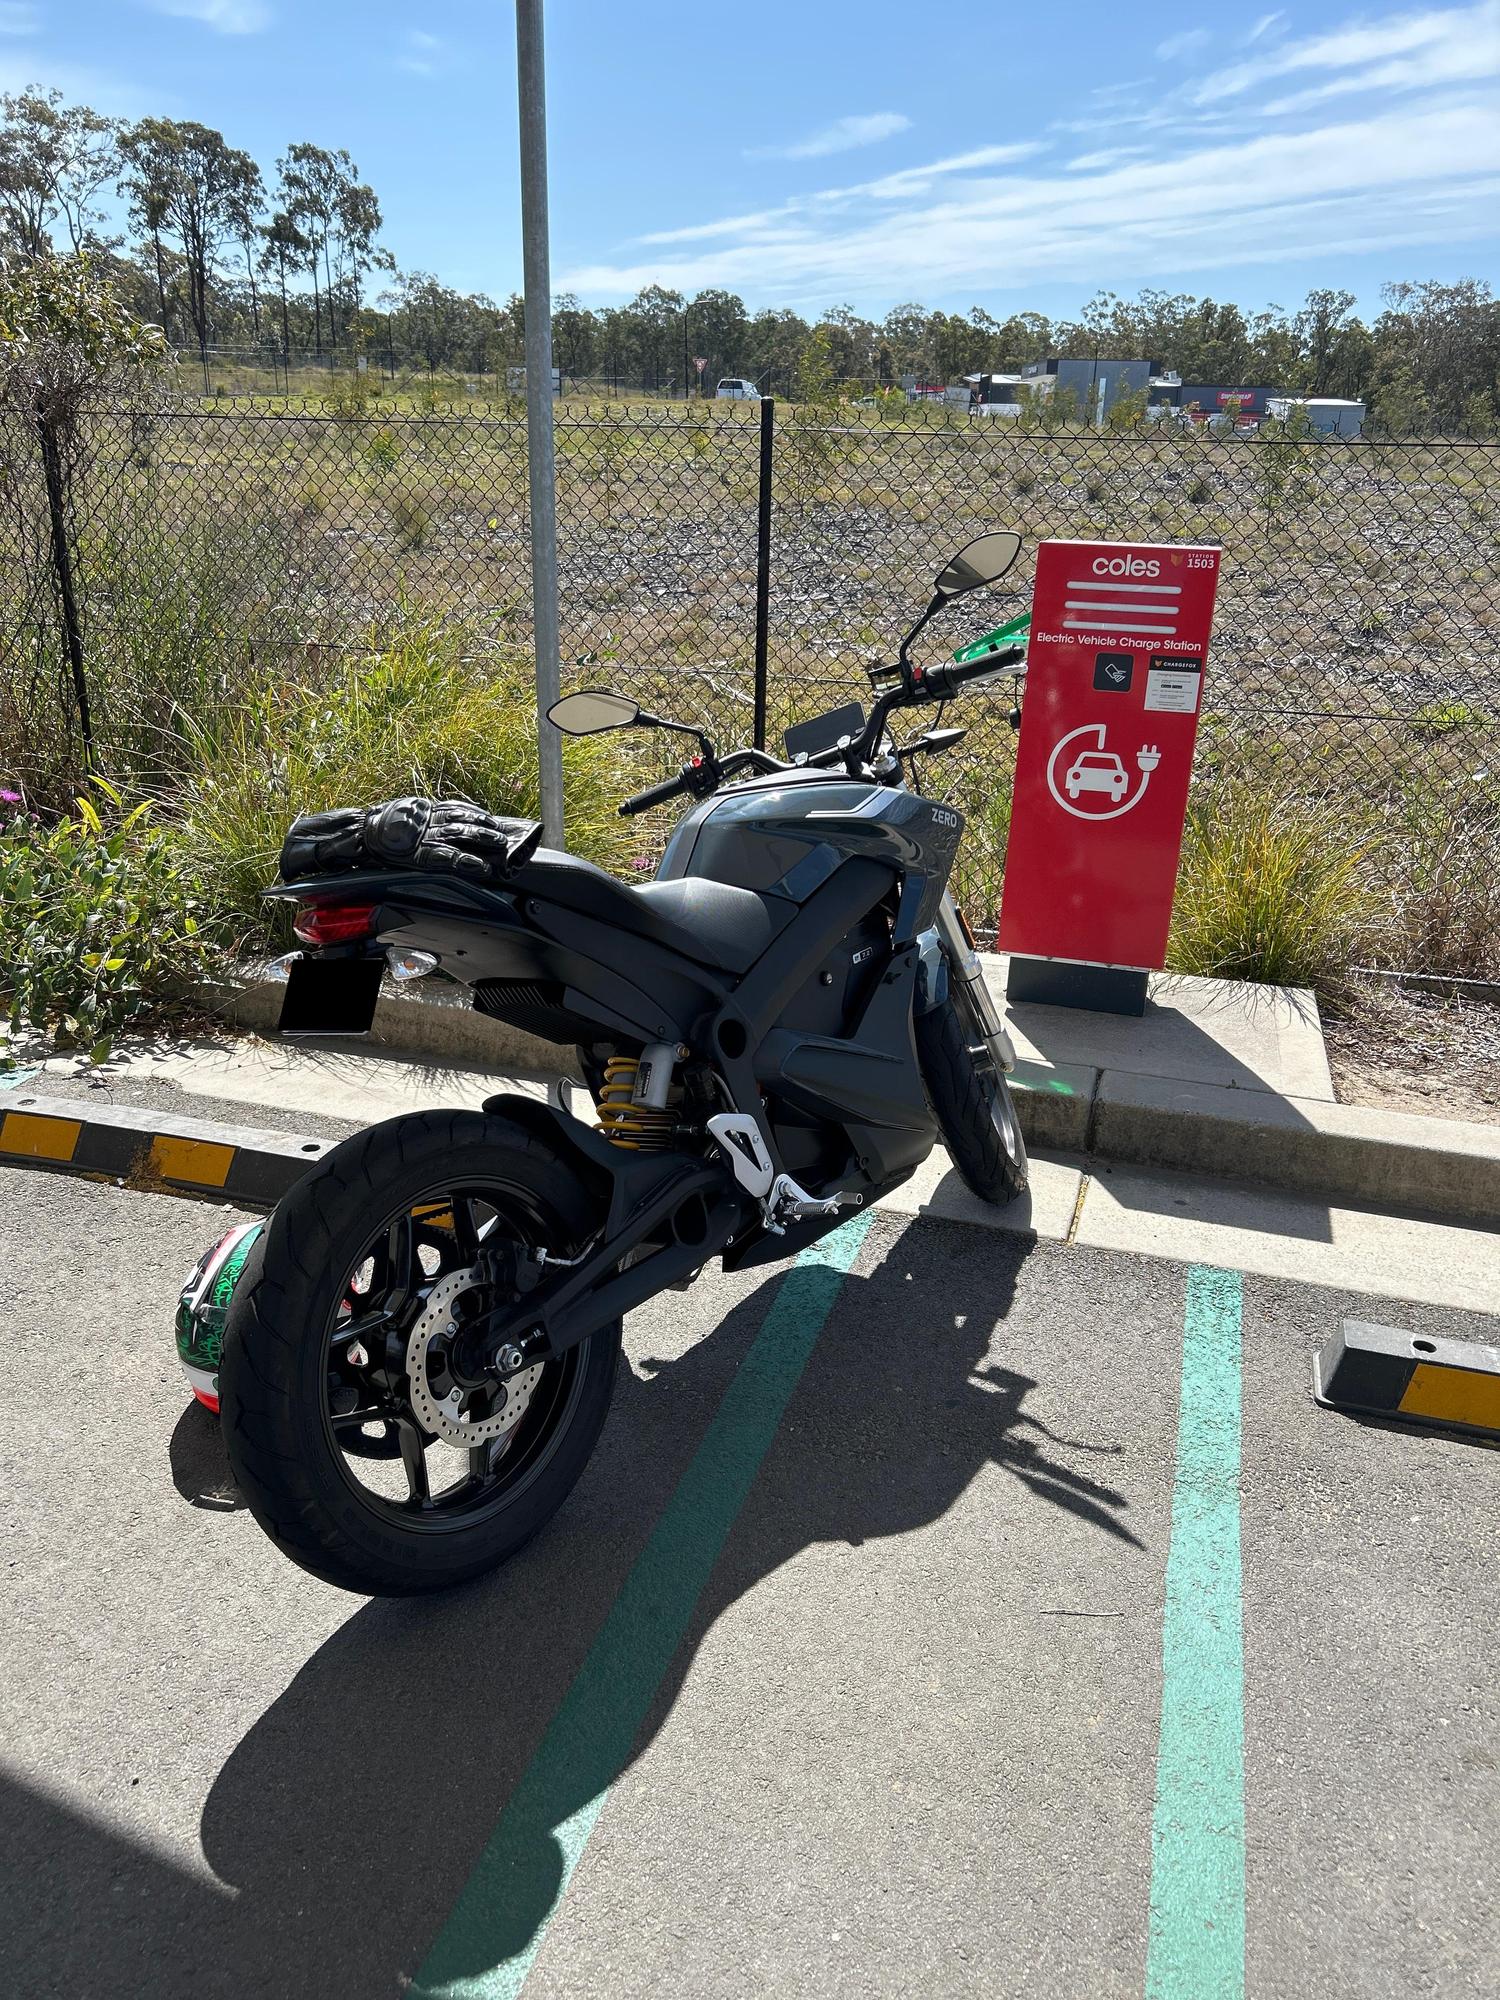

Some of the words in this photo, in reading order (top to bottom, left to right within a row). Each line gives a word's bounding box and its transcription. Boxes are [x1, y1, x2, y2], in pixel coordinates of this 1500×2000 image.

[1092, 553, 1161, 578] coles
[1186, 559, 1215, 569] 1503
[1036, 632, 1075, 644] Electric
[1077, 634, 1117, 646] Vehicle
[1119, 637, 1161, 650] Charge
[1163, 639, 1202, 651] Station
[931, 807, 958, 828] ZERO
